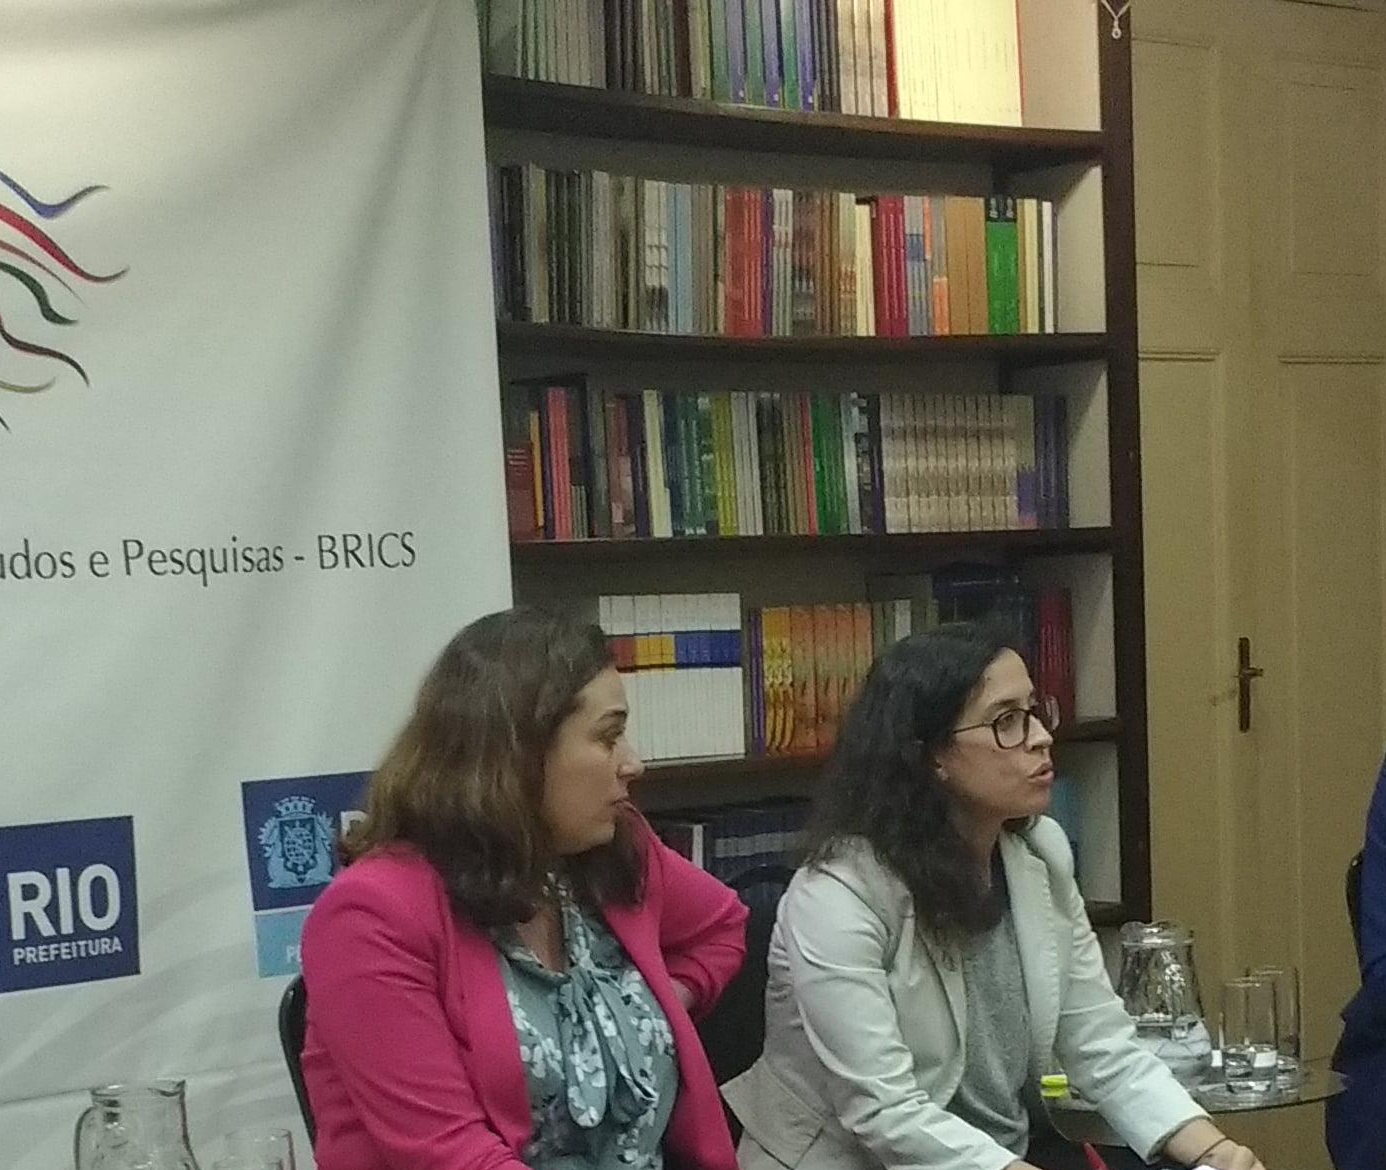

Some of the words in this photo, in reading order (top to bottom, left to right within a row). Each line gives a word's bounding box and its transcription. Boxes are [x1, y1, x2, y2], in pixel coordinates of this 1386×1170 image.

[88, 552, 110, 578] e
[122, 537, 285, 587] Pesquisas
[317, 531, 416, 570] BRICS
[7, 863, 121, 940] RIO
[13, 935, 123, 966] PREFEITURA
